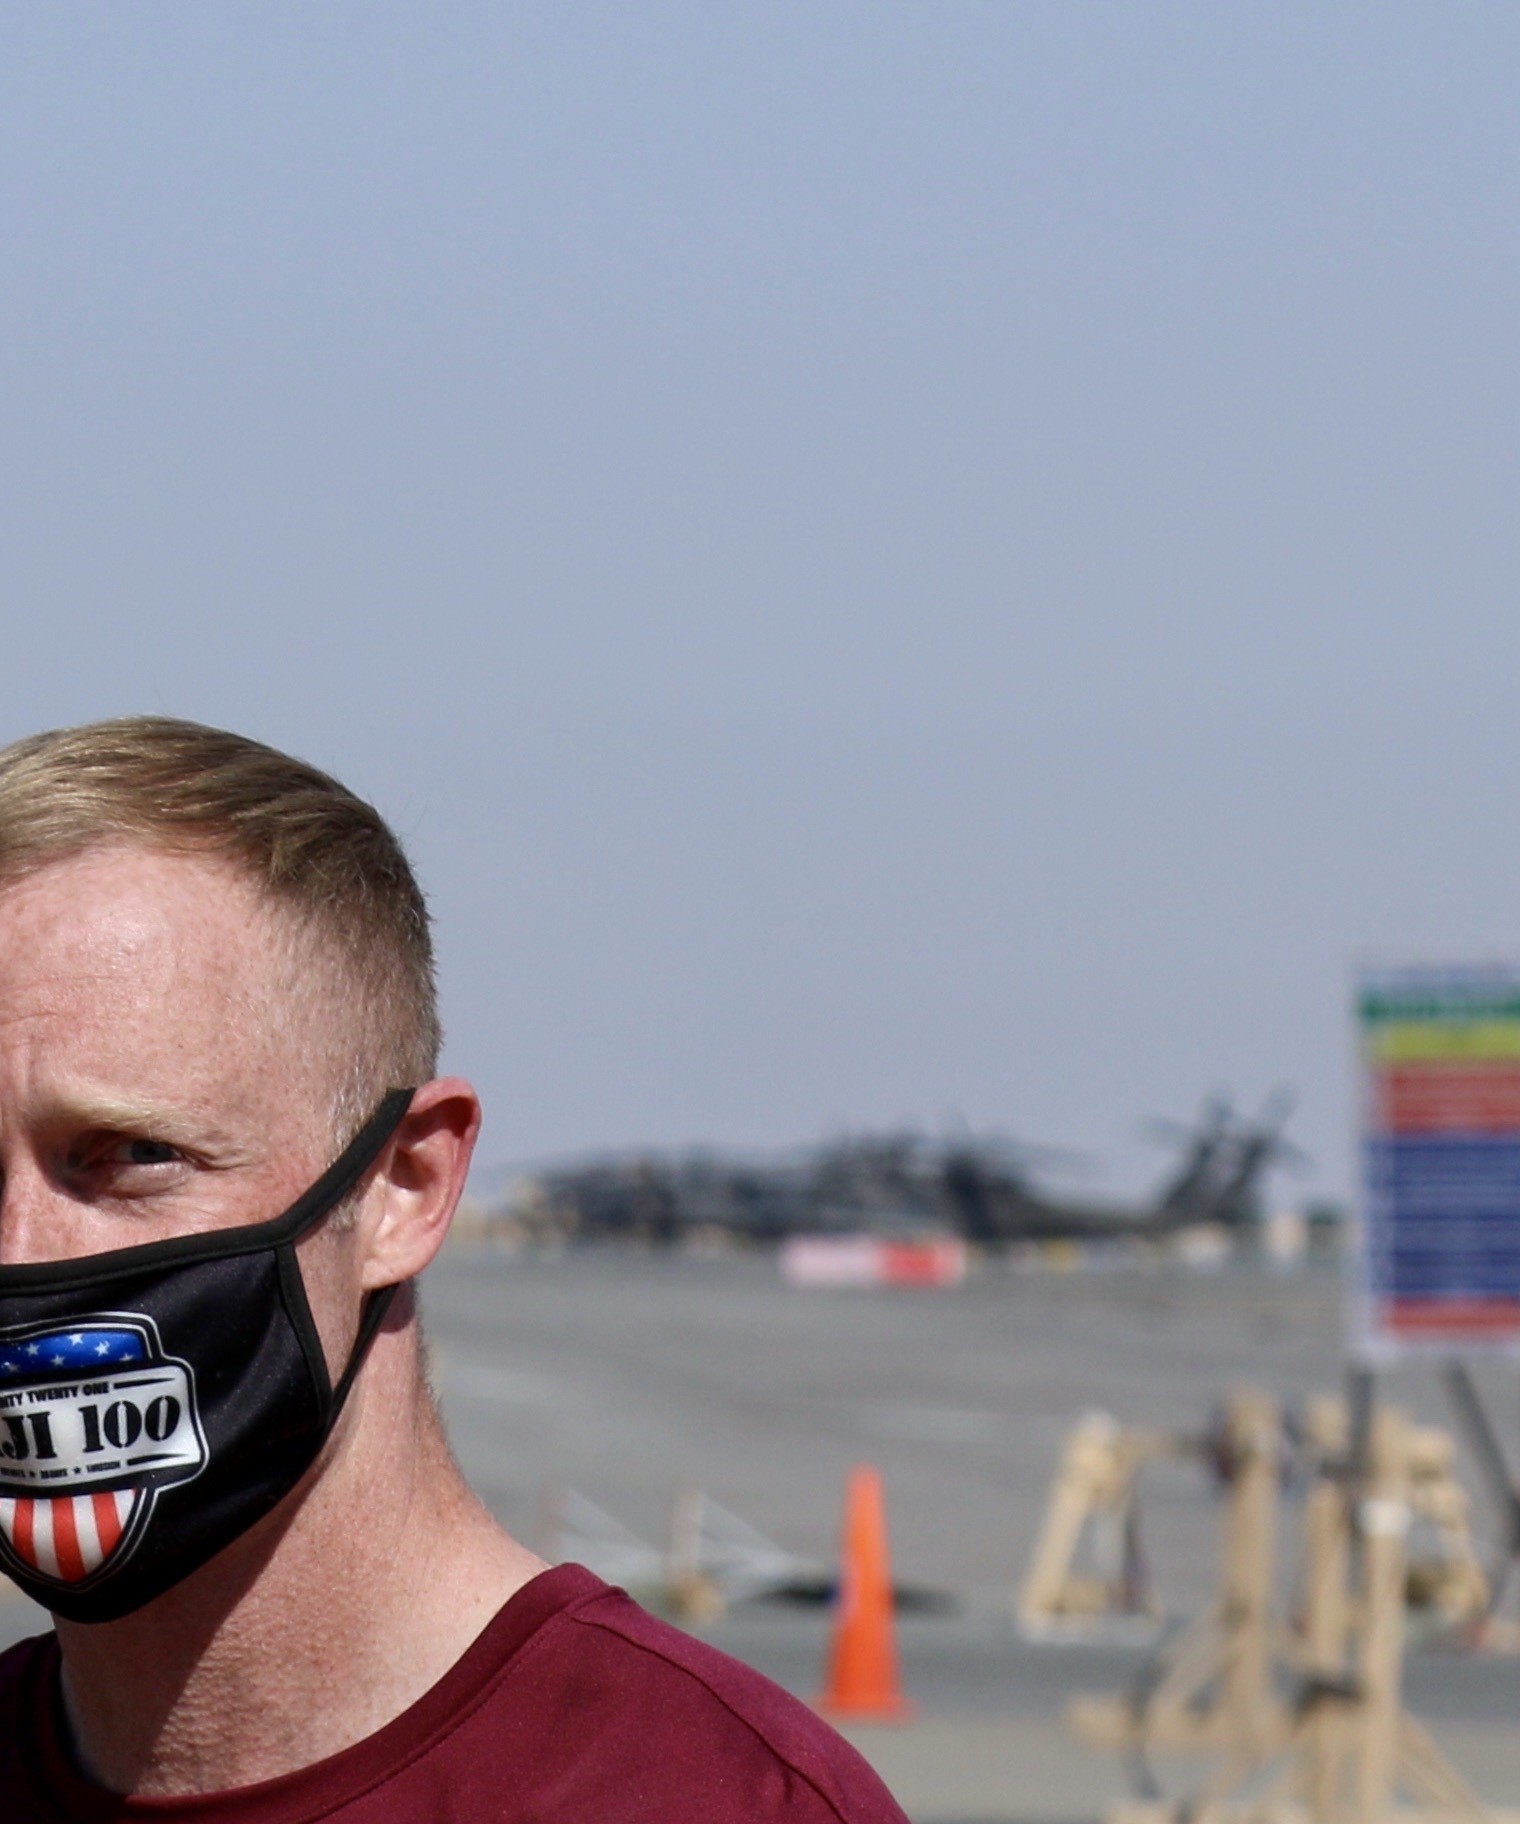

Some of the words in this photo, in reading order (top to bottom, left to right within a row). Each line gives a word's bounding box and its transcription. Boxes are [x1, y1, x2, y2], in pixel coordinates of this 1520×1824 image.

[26, 1386, 79, 1403] TWENTY
[83, 1382, 109, 1396] ONE
[78, 1395, 181, 1453] 100
